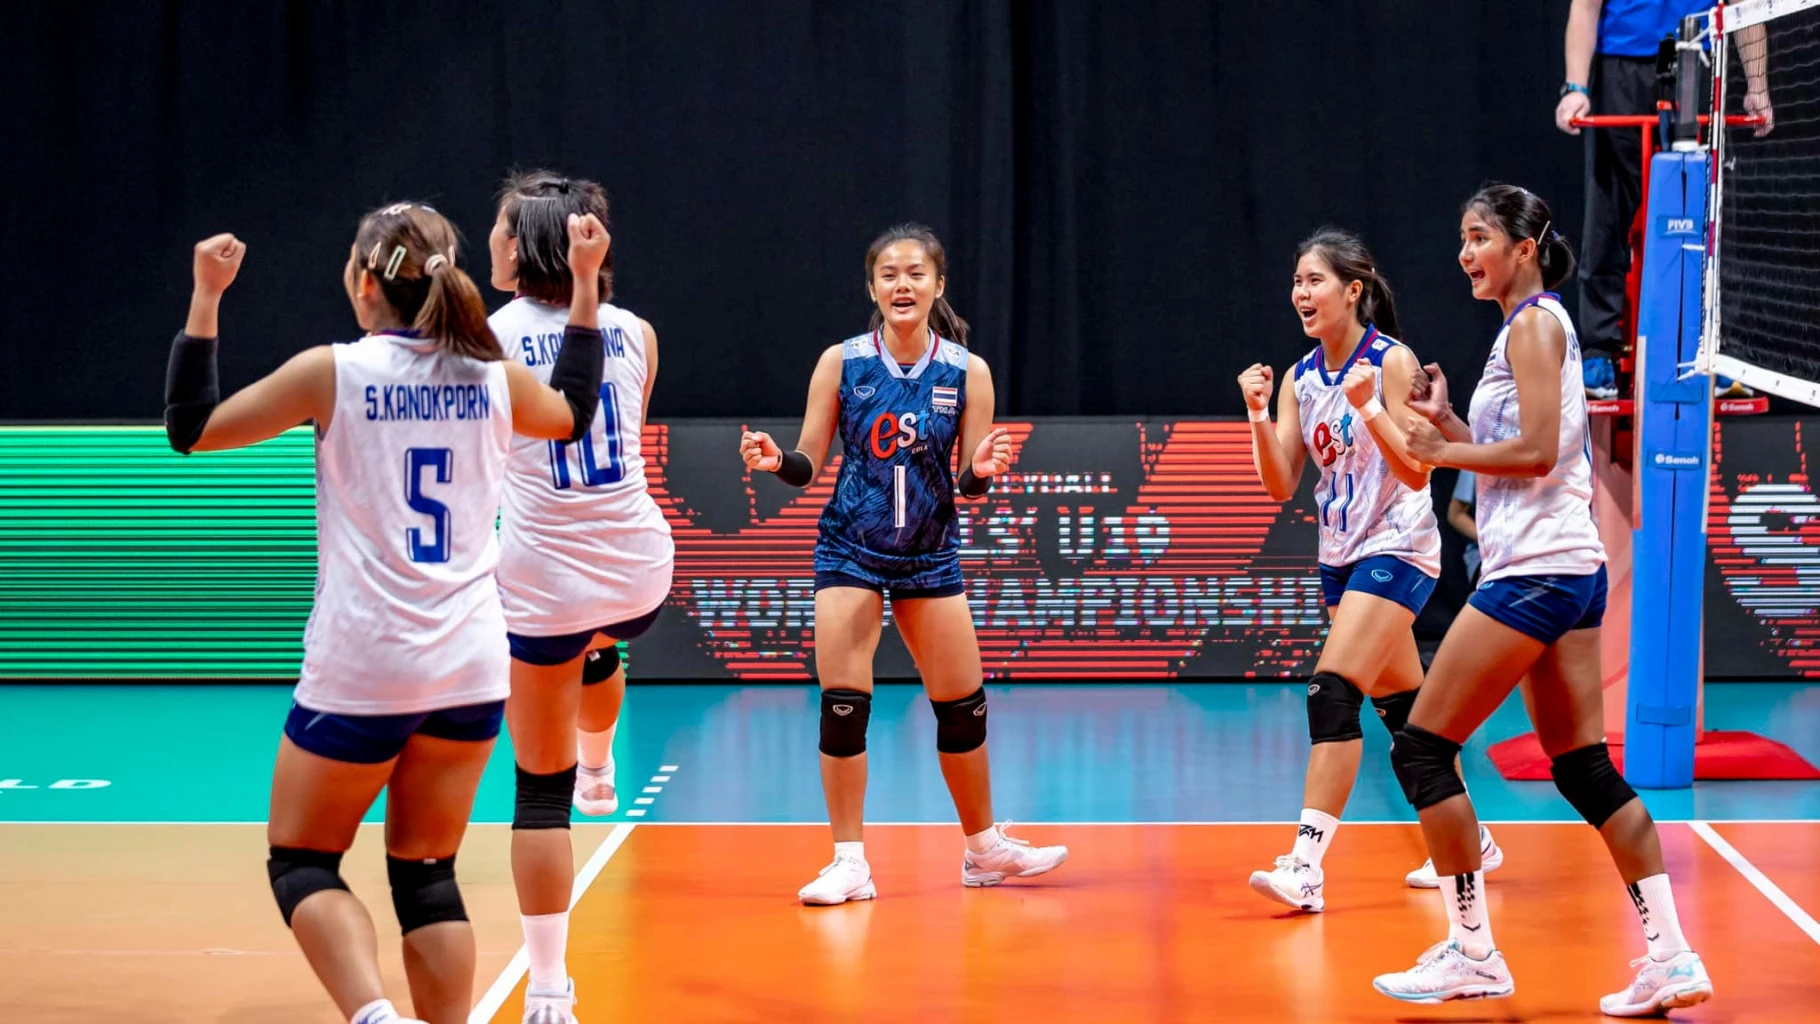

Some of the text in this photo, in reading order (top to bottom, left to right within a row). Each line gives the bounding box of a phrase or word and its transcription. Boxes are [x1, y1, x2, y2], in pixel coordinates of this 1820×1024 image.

[1667, 218, 1694, 230] FIVB
[365, 384, 490, 421] S.KANOKPORN
[870, 408, 931, 459] est
[1313, 413, 1354, 467] est
[1665, 455, 1699, 465] Senoh
[405, 447, 453, 563] 5
[894, 465, 906, 528] 1
[1321, 470, 1354, 532] 11
